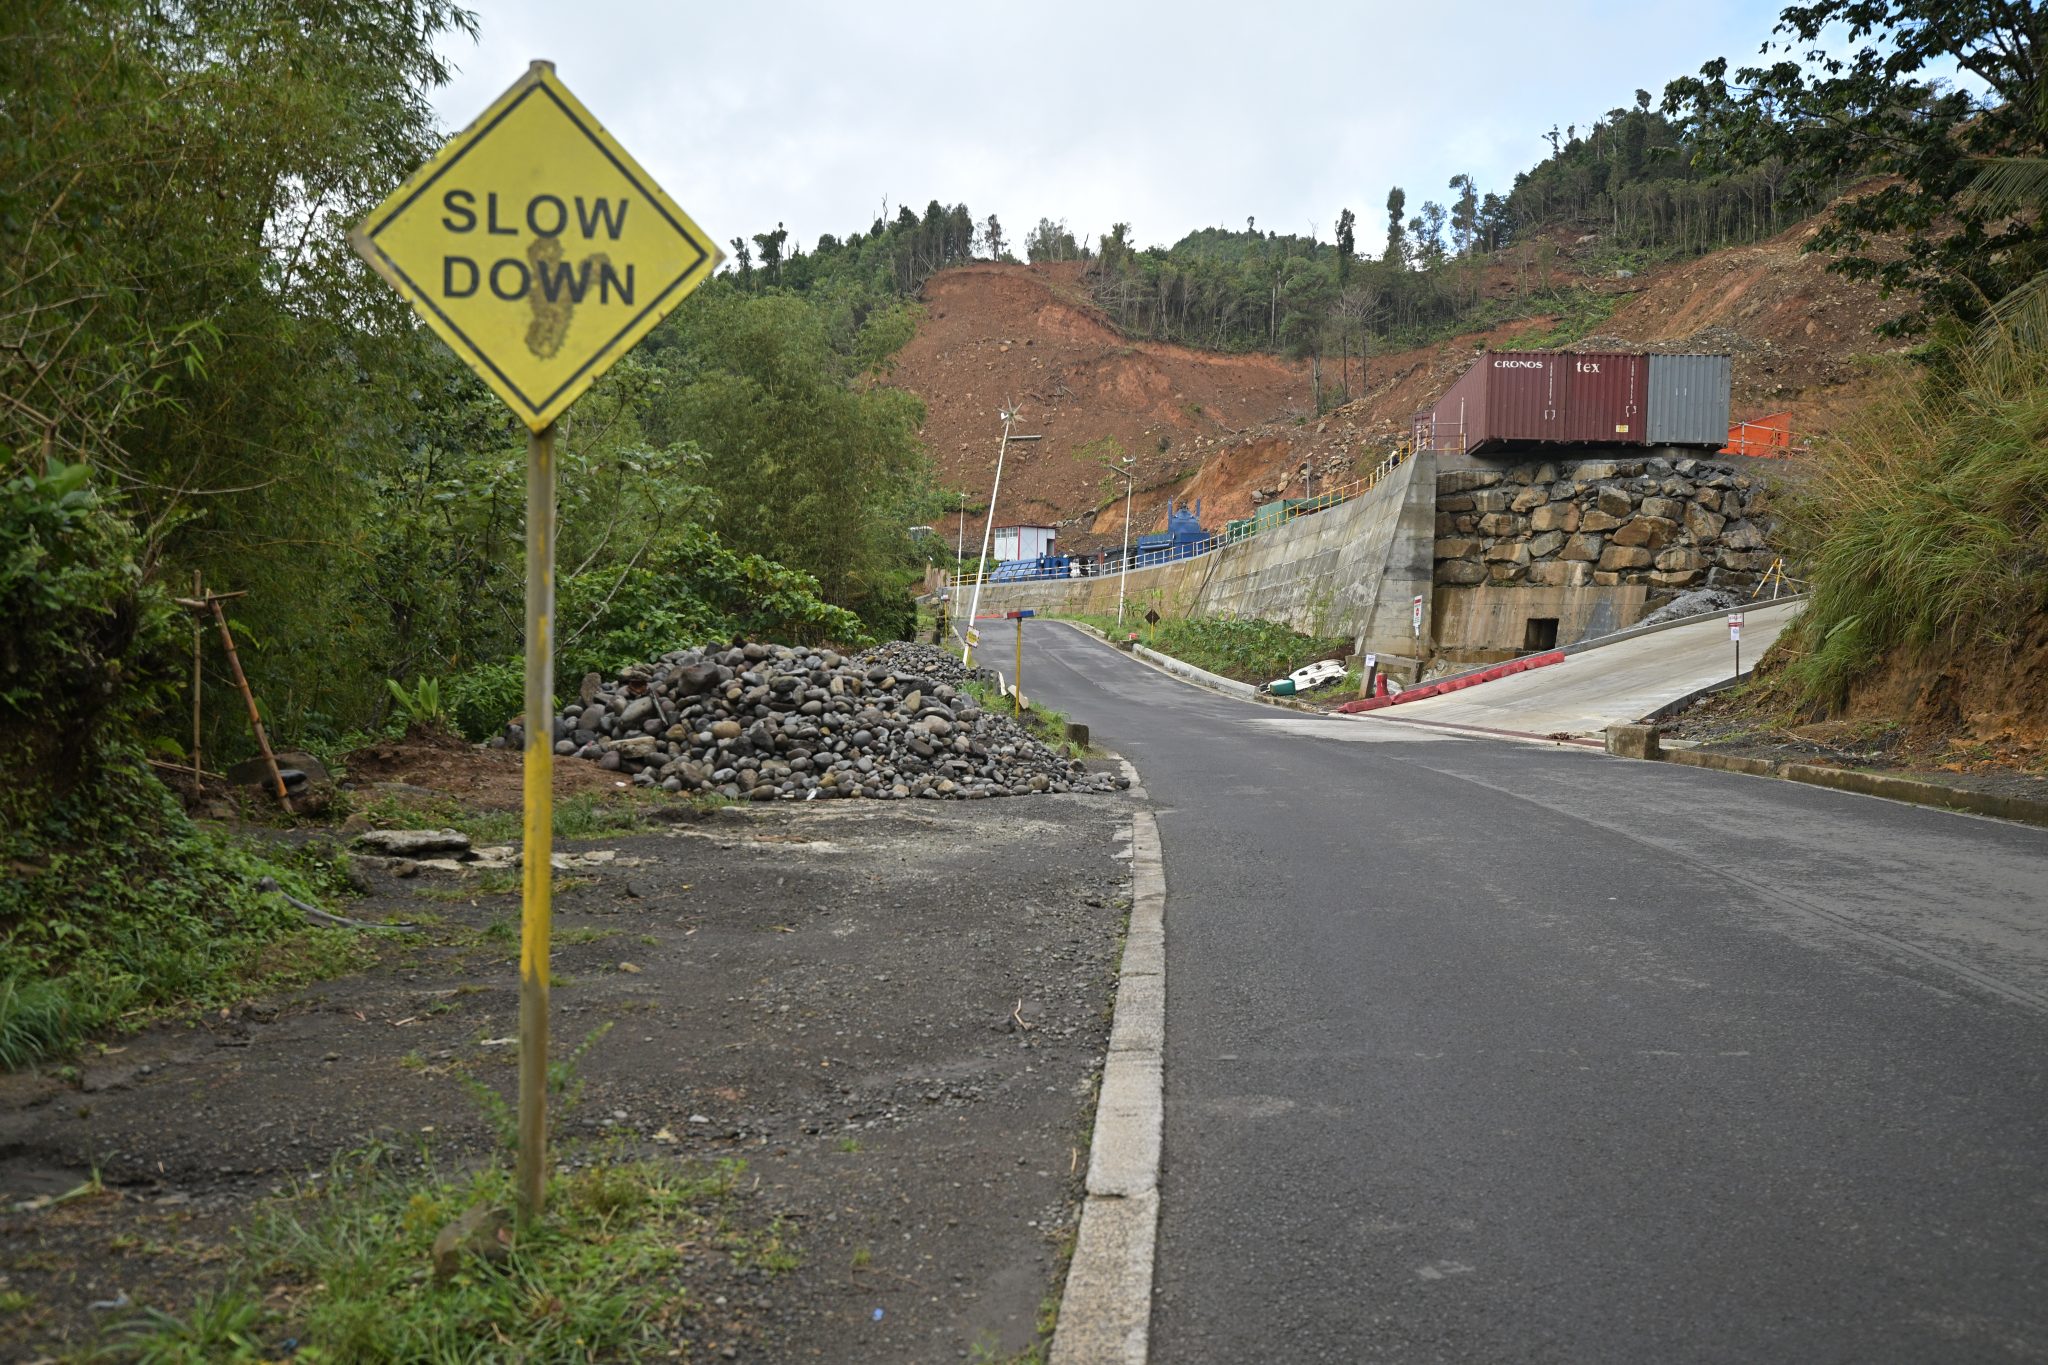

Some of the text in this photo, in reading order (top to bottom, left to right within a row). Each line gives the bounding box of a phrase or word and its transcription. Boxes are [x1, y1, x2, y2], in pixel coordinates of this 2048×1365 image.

[441, 189, 630, 240] SLOW
[443, 256, 636, 306] DOWN
[1494, 360, 1543, 369] CRONOS
[1576, 361, 1600, 373] tex
